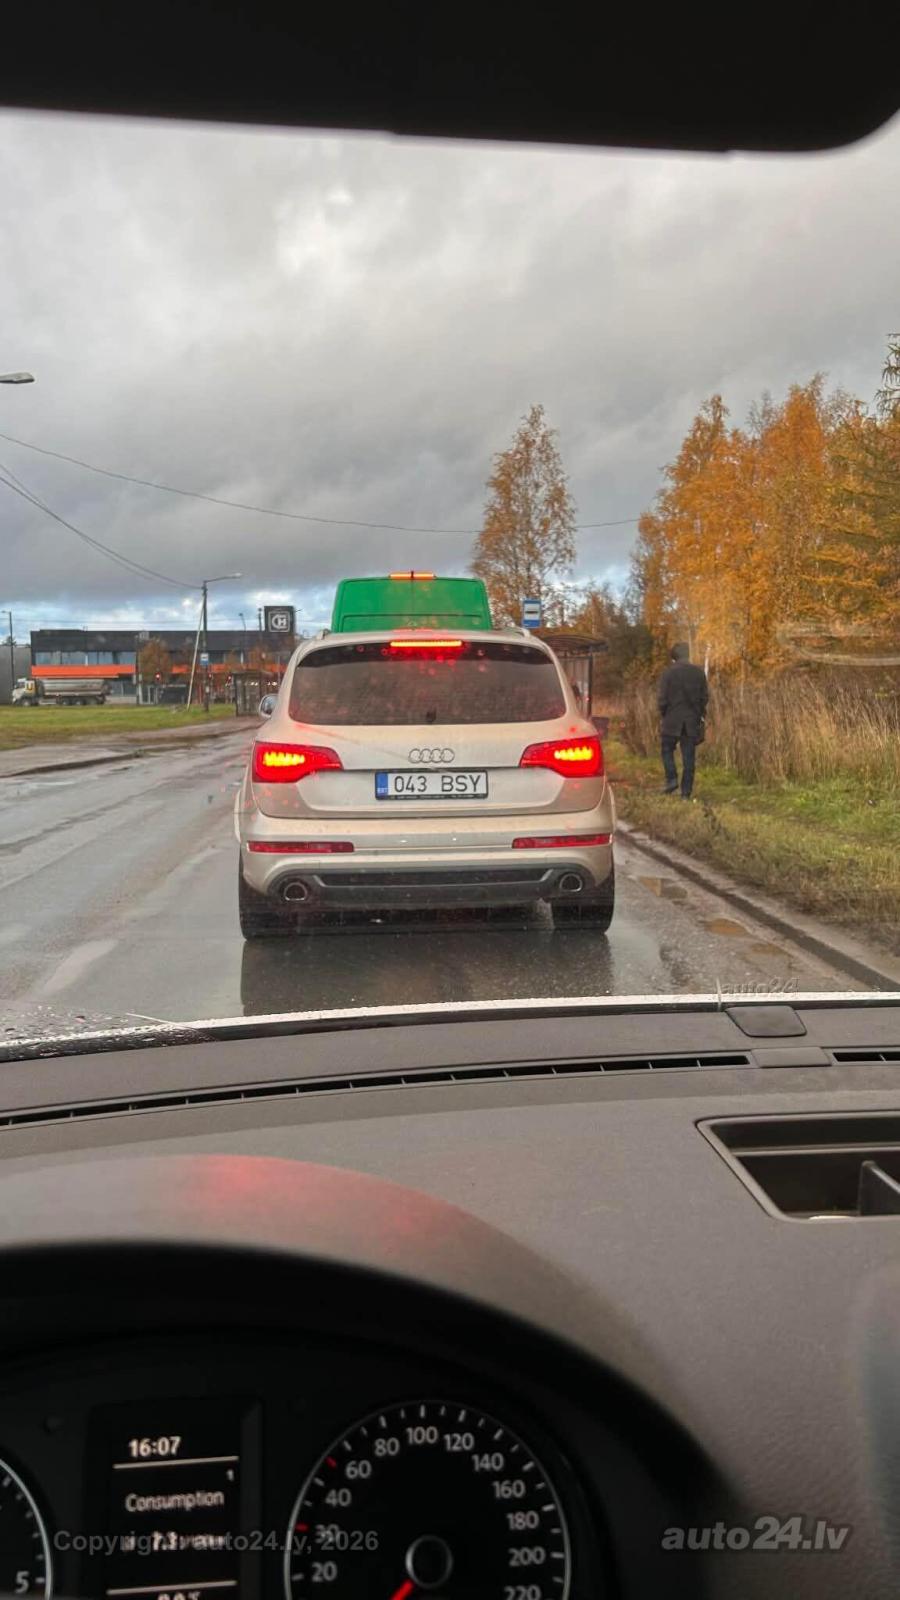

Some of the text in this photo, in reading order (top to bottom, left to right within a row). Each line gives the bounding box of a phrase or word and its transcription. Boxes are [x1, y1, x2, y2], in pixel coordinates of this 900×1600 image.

[394, 775, 481, 793] 043 BSY
[406, 1426, 438, 1445] 100
[444, 1433, 475, 1451] 120
[129, 1436, 181, 1457] 16:07
[375, 1437, 399, 1456] 80
[346, 1460, 372, 1479] 60
[472, 1453, 504, 1471] 140
[326, 1488, 351, 1506] 40
[493, 1480, 526, 1498] 160
[125, 1491, 225, 1512] Consumption
[507, 1511, 539, 1530] 180
[315, 1524, 340, 1543] 30
[509, 1547, 545, 1566] 200
[311, 1562, 337, 1582] 20
[15, 1571, 29, 1594] 5
[504, 1585, 541, 1600] 220
